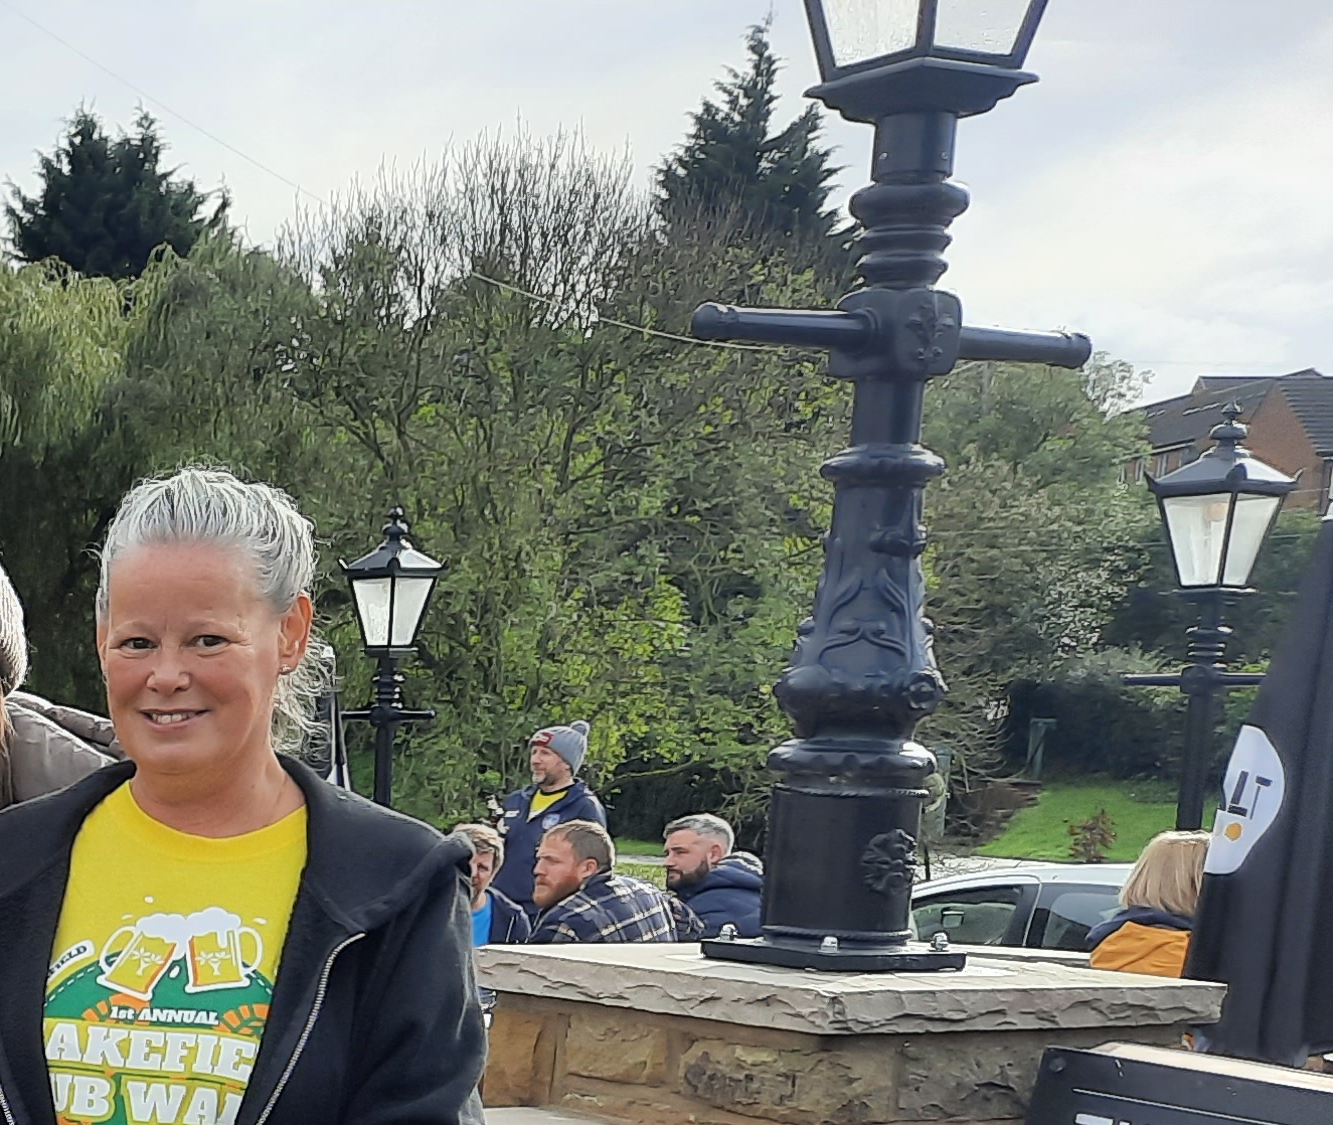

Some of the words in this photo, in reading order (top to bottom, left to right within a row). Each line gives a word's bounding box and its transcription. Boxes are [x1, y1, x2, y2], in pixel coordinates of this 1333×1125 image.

[110, 1005, 136, 1021] 1st
[137, 1006, 220, 1026] ANNUAL
[45, 1022, 260, 1083] AKEFIE
[49, 1072, 113, 1117] UB
